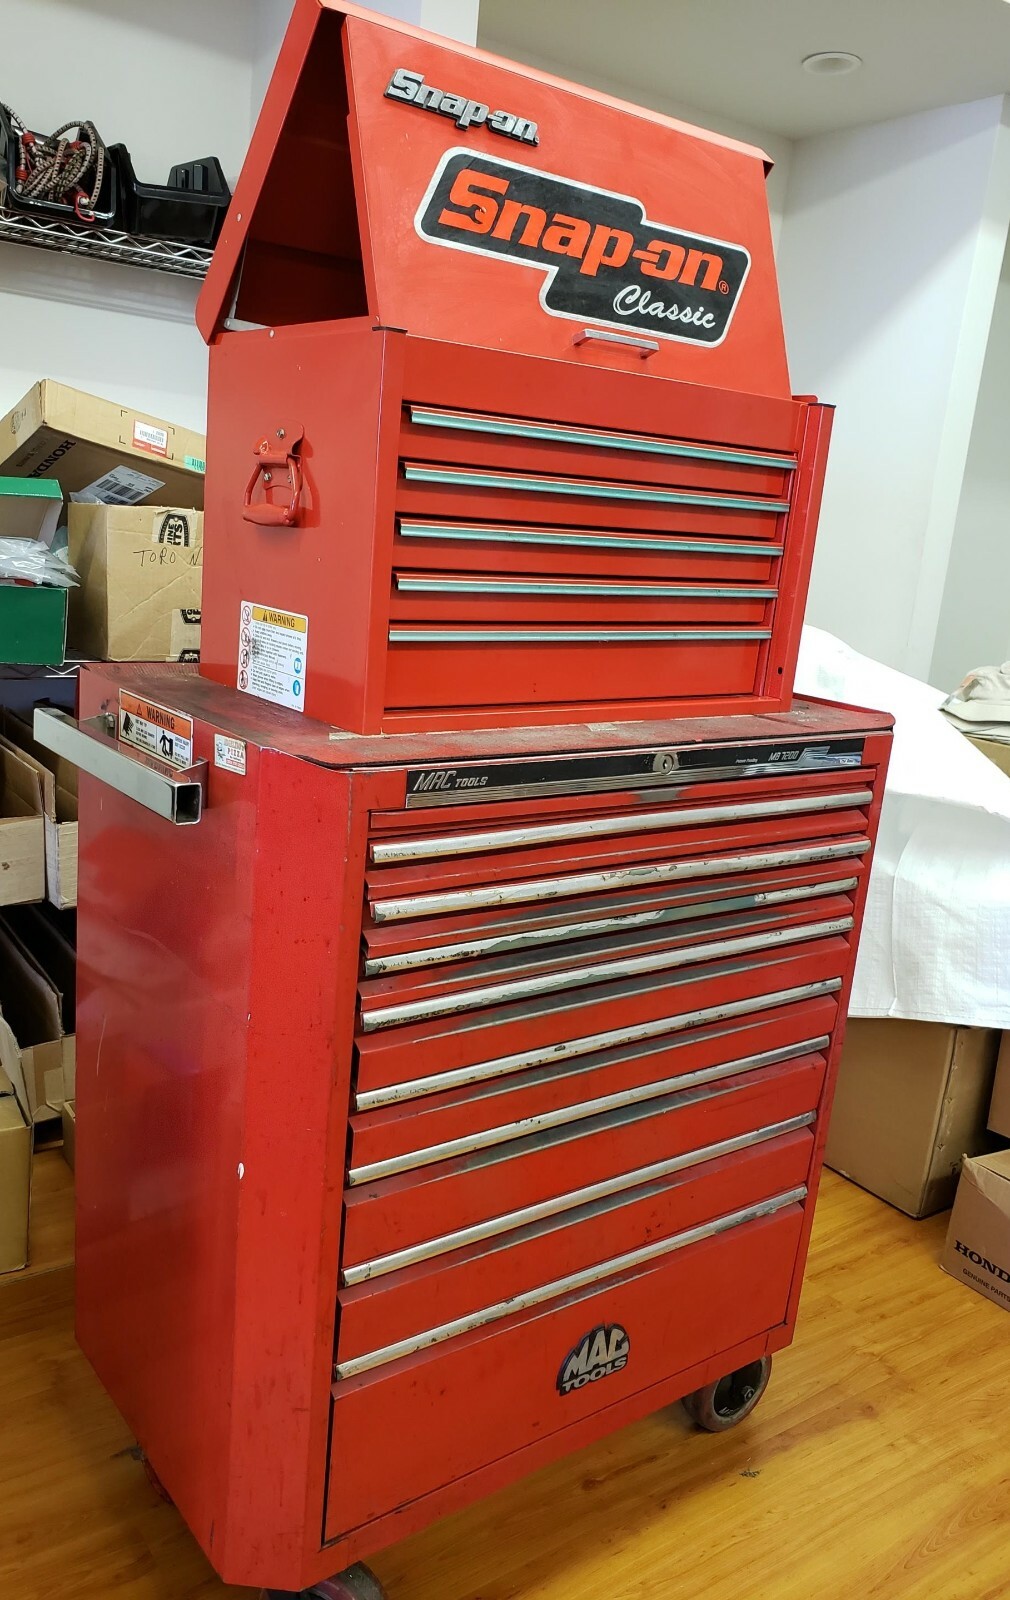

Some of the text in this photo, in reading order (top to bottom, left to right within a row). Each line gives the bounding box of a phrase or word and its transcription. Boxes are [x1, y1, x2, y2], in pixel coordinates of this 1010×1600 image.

[386, 68, 537, 143] Snap-on
[438, 168, 725, 292] Snap-on
[613, 284, 716, 329] Classic
[26, 440, 77, 478] HONDA
[133, 547, 176, 567] TORO
[268, 611, 296, 628] WARNING
[146, 705, 176, 730] WARNING
[413, 770, 489, 791] MAC TOOLS
[962, 1268, 990, 1289] GENUINE
[562, 1328, 630, 1382] MAC
[562, 1356, 627, 1392] TOOLS
